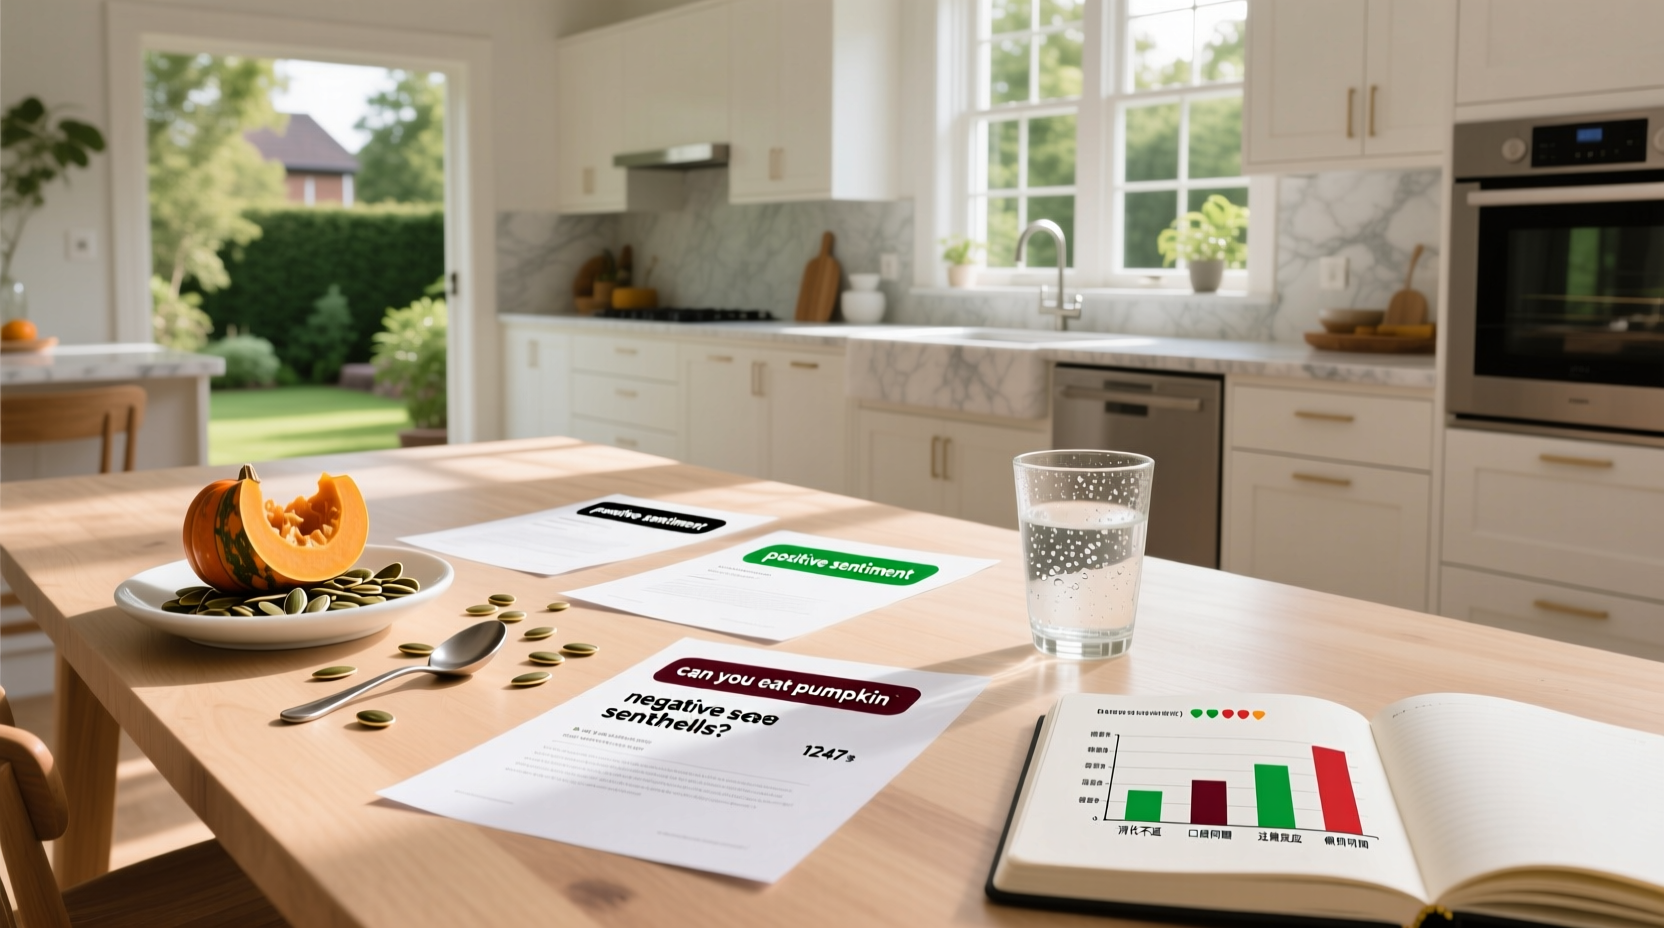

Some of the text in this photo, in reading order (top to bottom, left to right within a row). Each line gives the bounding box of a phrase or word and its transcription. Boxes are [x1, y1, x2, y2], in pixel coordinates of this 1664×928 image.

[829, 560, 915, 580] sentiment
[676, 665, 890, 706] can you eat pumpkin
[624, 692, 726, 718] negative
